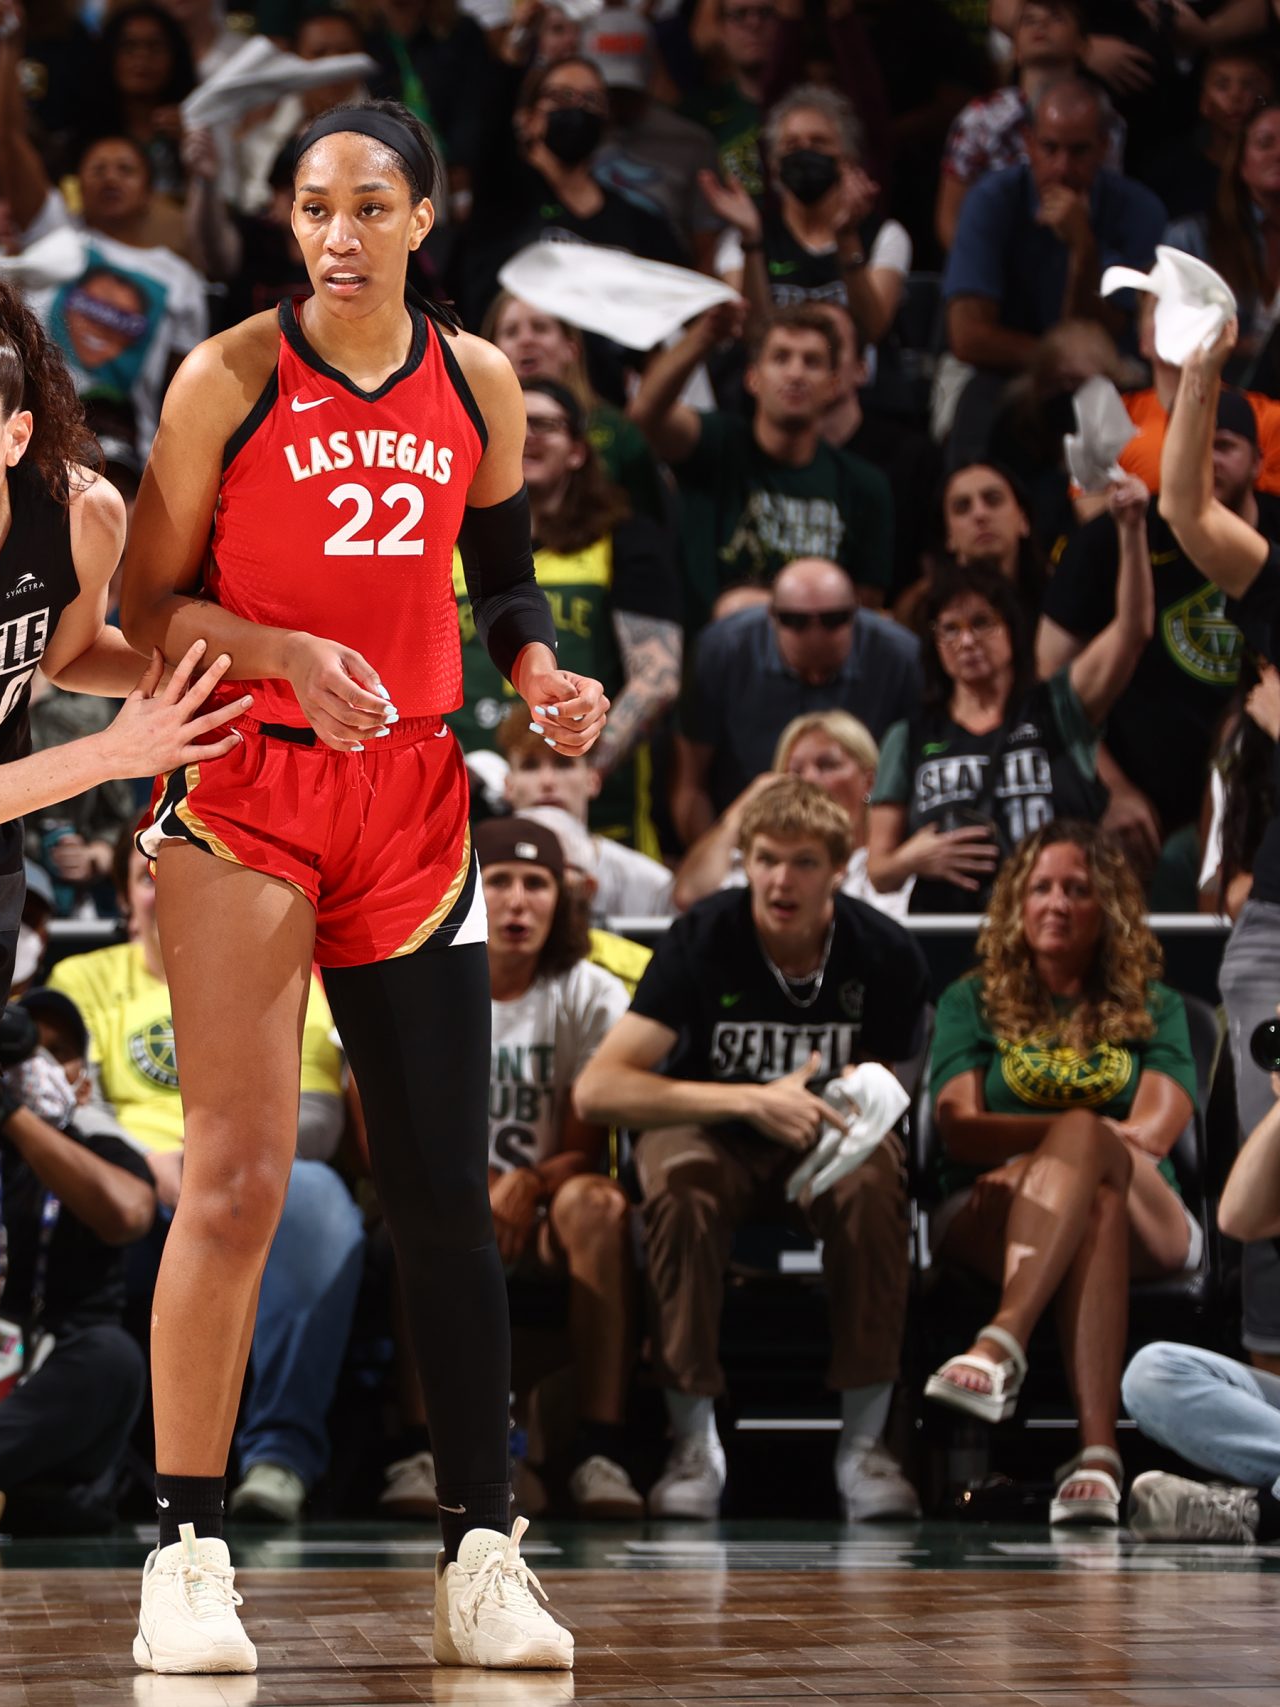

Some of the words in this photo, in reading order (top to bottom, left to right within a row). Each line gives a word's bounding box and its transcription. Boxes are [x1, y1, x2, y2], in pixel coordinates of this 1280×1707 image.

[283, 430, 355, 483] LAS
[354, 429, 454, 485] VEGAS
[323, 482, 425, 556] 22
[5, 581, 45, 600] SYMETRA
